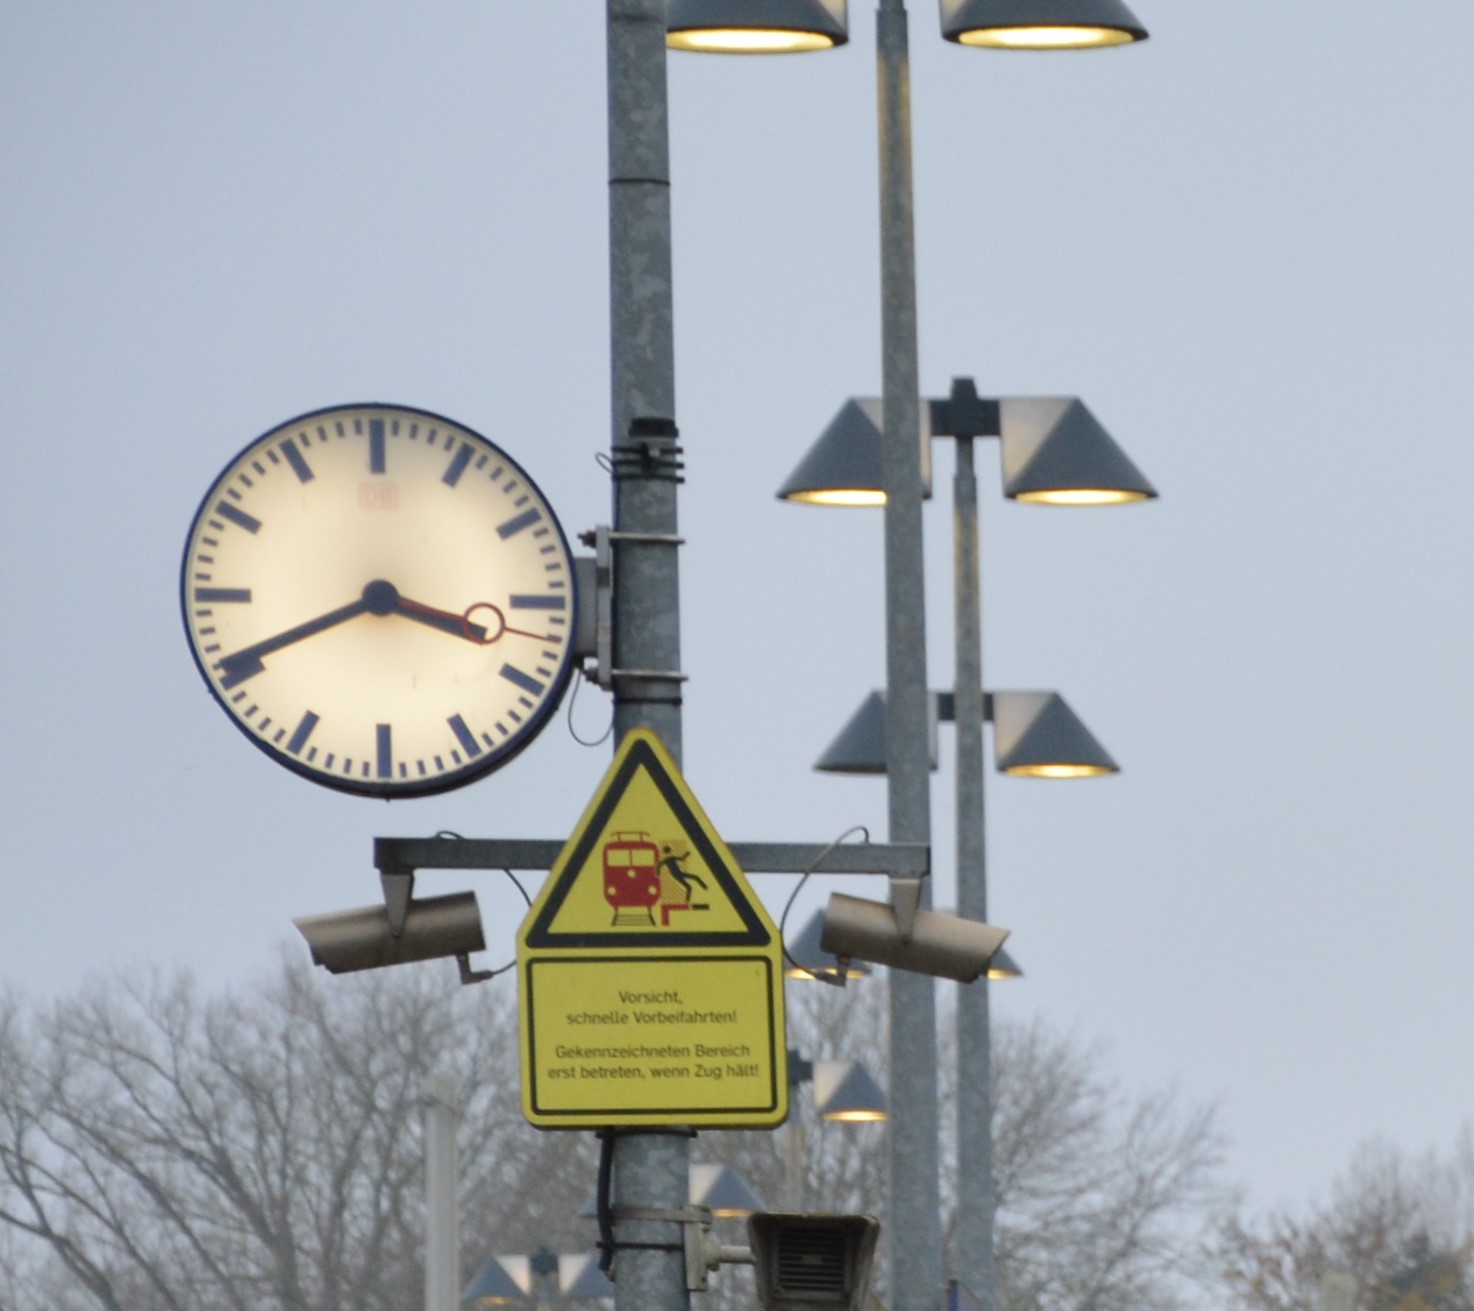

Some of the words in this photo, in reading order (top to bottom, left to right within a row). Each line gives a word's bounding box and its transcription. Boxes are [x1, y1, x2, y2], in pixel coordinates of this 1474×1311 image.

[619, 990, 683, 1005] Vorsicht,
[566, 1010, 629, 1025] schnelle
[633, 1010, 737, 1025] Vorbeifahrten!
[556, 1045, 691, 1059] Gekennzeichneten
[695, 1043, 751, 1058] Bereich
[548, 1066, 577, 1079] erst
[580, 1065, 645, 1080] betreten,
[650, 1067, 690, 1079] wenn
[694, 1064, 723, 1081] Zug
[726, 1063, 759, 1078] hält!
